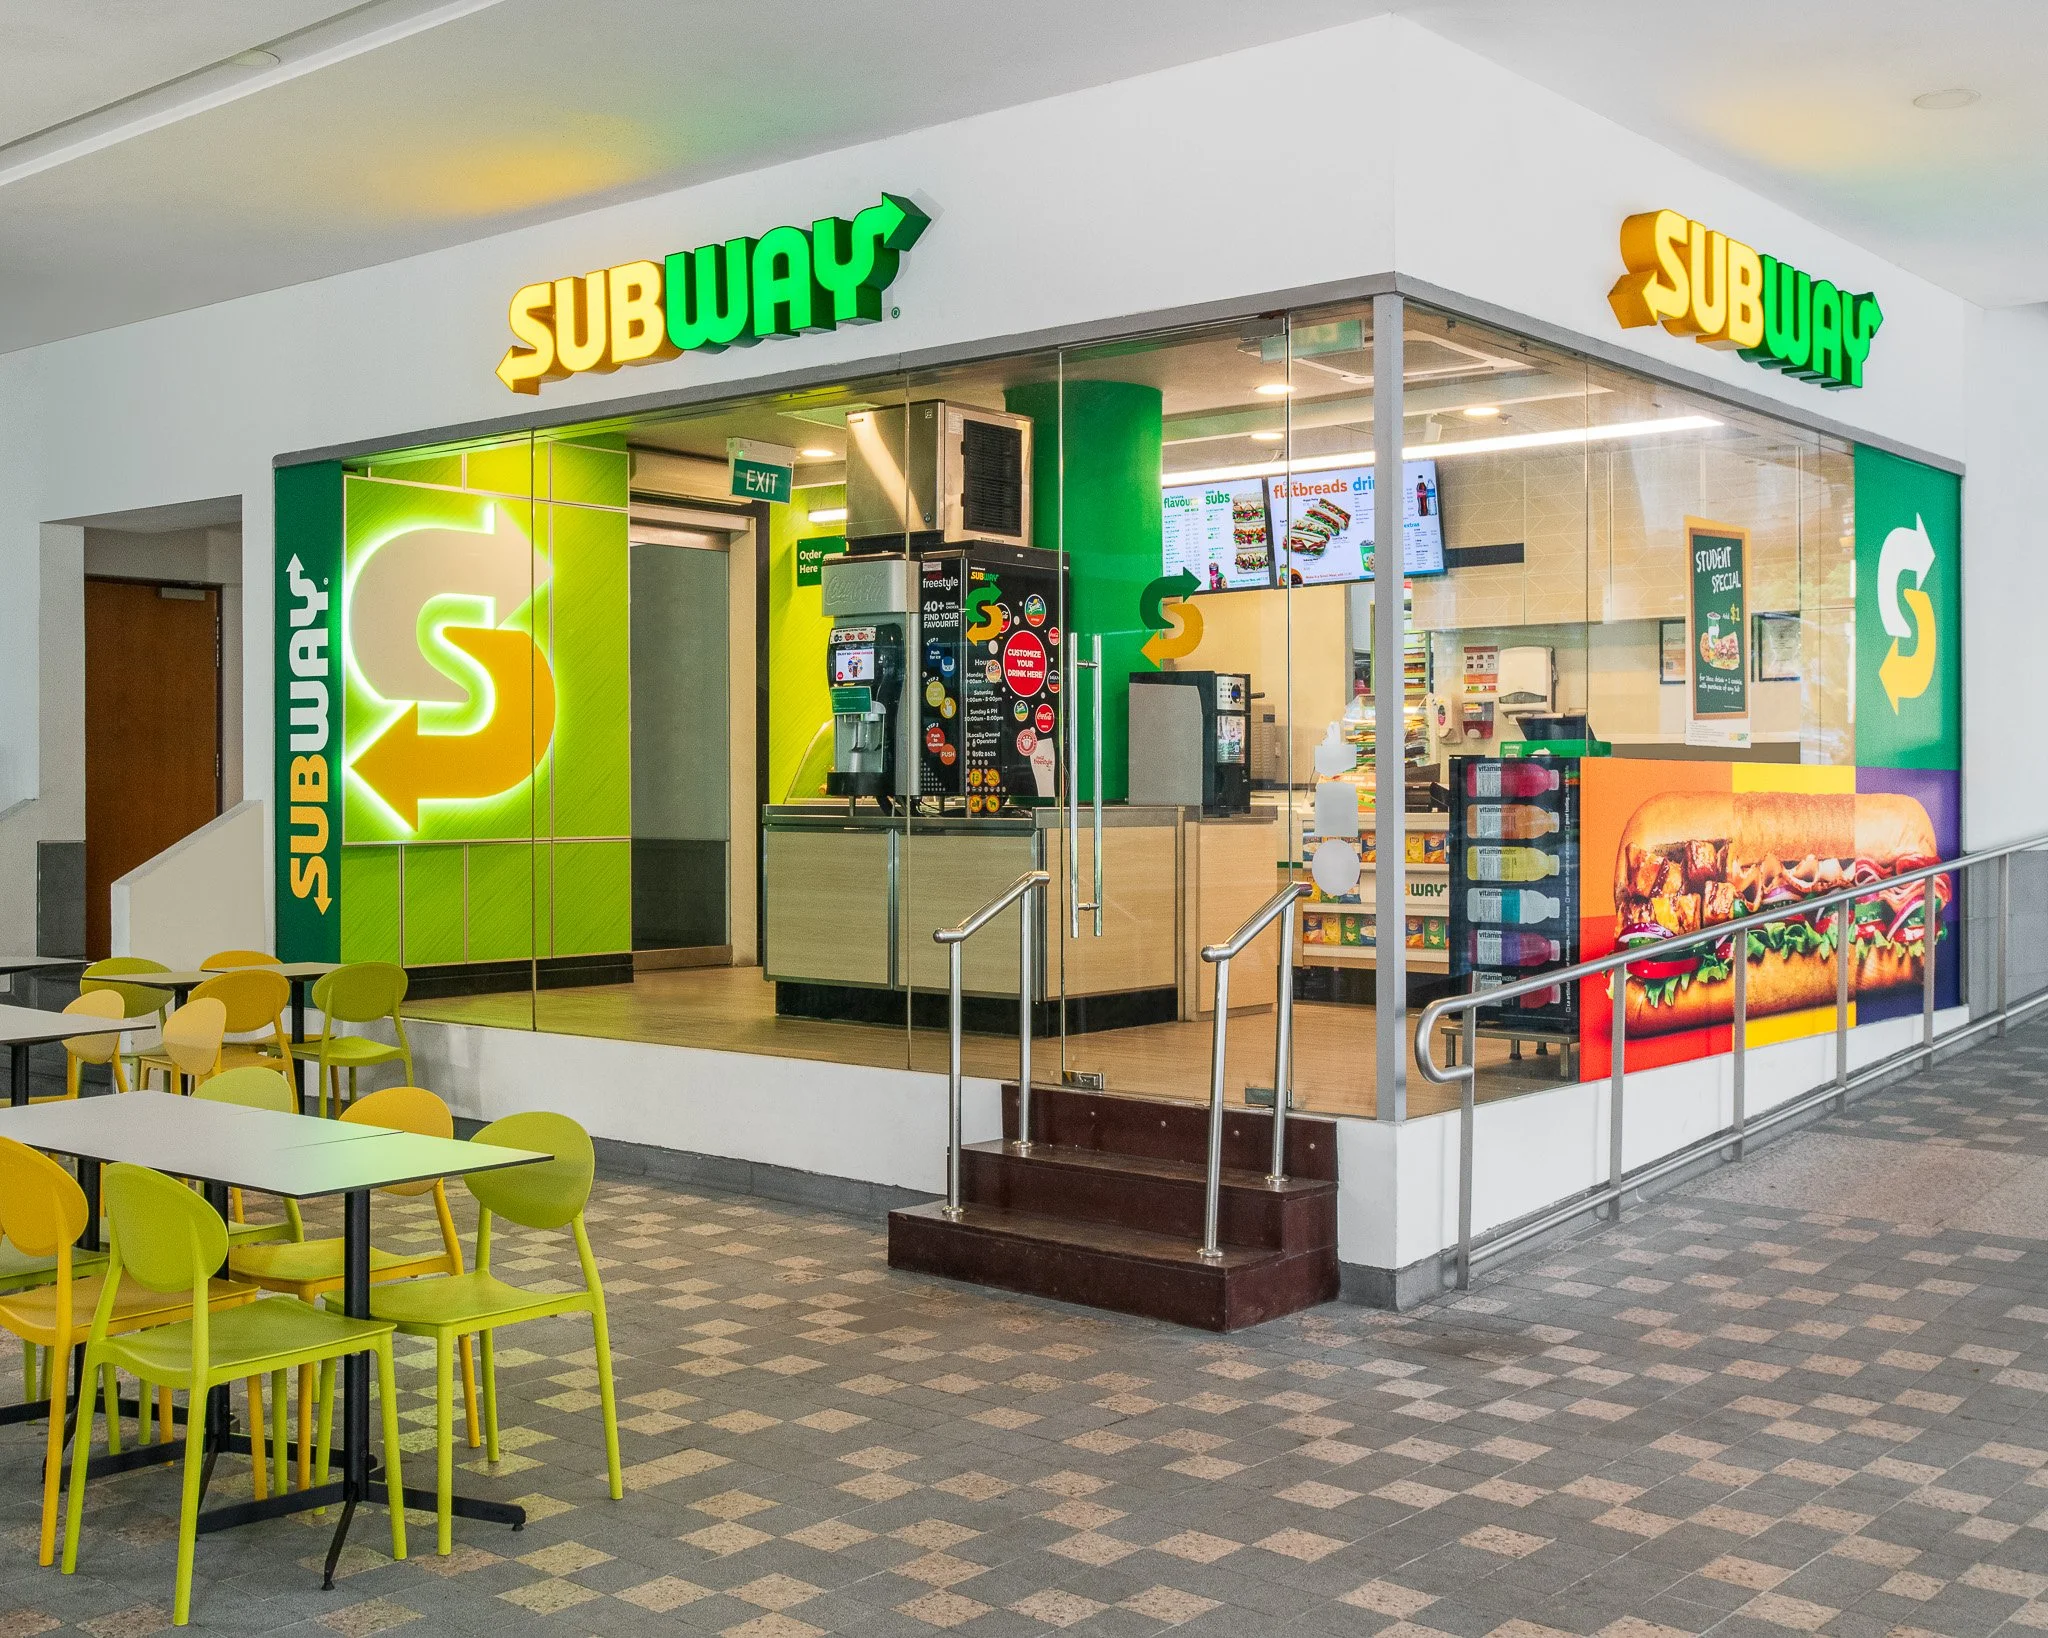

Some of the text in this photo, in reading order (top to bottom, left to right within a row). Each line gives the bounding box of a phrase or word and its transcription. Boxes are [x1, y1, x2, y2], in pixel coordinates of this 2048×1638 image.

[495, 192, 932, 395] SUBWAY
[1607, 209, 1883, 389] SUBWAY
[746, 469, 779, 495] EXIT
[1163, 497, 1197, 509] flavou
[1205, 490, 1231, 505] subs
[800, 550, 822, 562] Order
[1695, 546, 1732, 573] STUDENT
[800, 564, 818, 574] Here
[970, 571, 1000, 582] SUBWAY
[1711, 570, 1741, 594] SPECIAL
[922, 576, 959, 591] freestyle
[923, 601, 945, 612] 40+
[923, 612, 959, 621] FIND YOUR
[1730, 603, 1741, 625] $1
[923, 620, 959, 629] FAVOURITE
[1007, 649, 1042, 658] CUSTOMIZE
[1016, 659, 1034, 668] YOUR
[1007, 669, 1043, 679] DRINK HERE
[290, 552, 333, 915] SUBWAY
